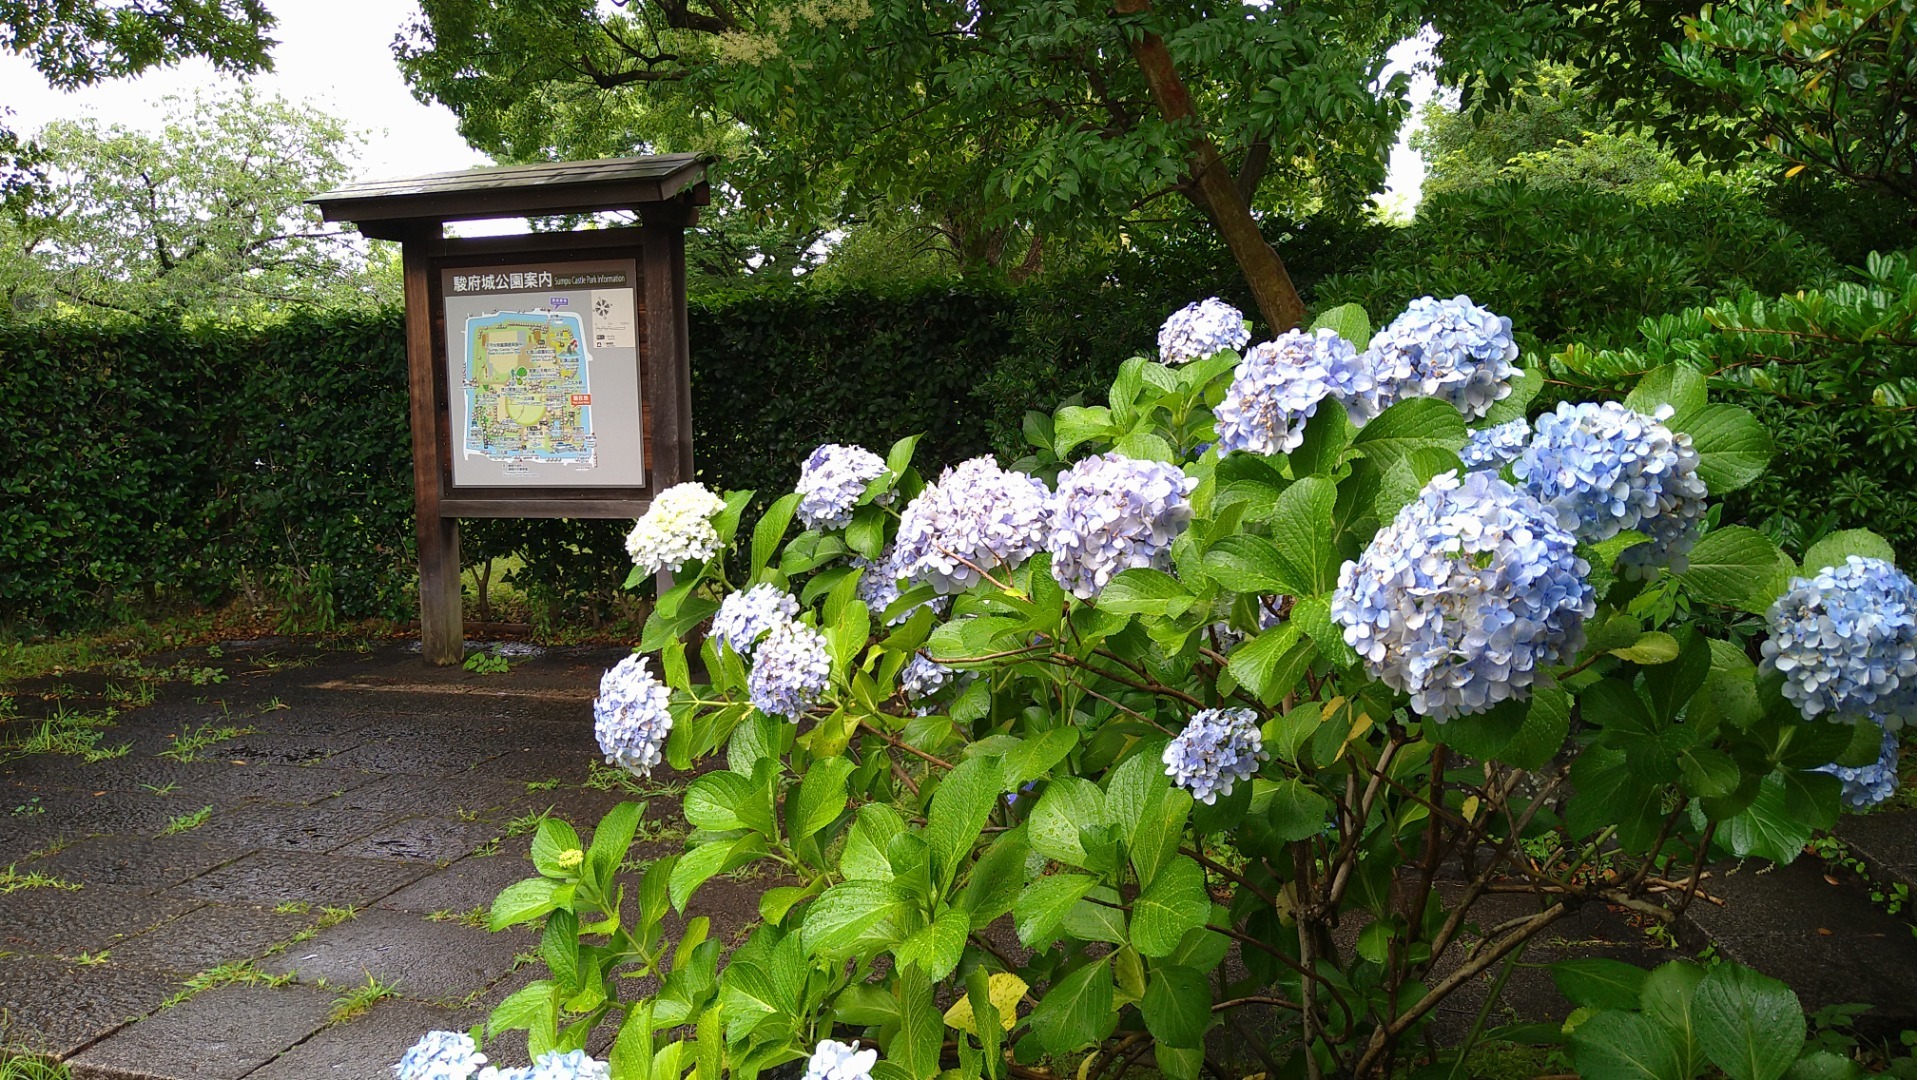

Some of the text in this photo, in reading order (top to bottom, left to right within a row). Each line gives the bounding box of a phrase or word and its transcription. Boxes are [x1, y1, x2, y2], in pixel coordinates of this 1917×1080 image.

[453, 271, 552, 292] 駿府城公園案内
[554, 273, 626, 286] Sumpu Castle Park Information
